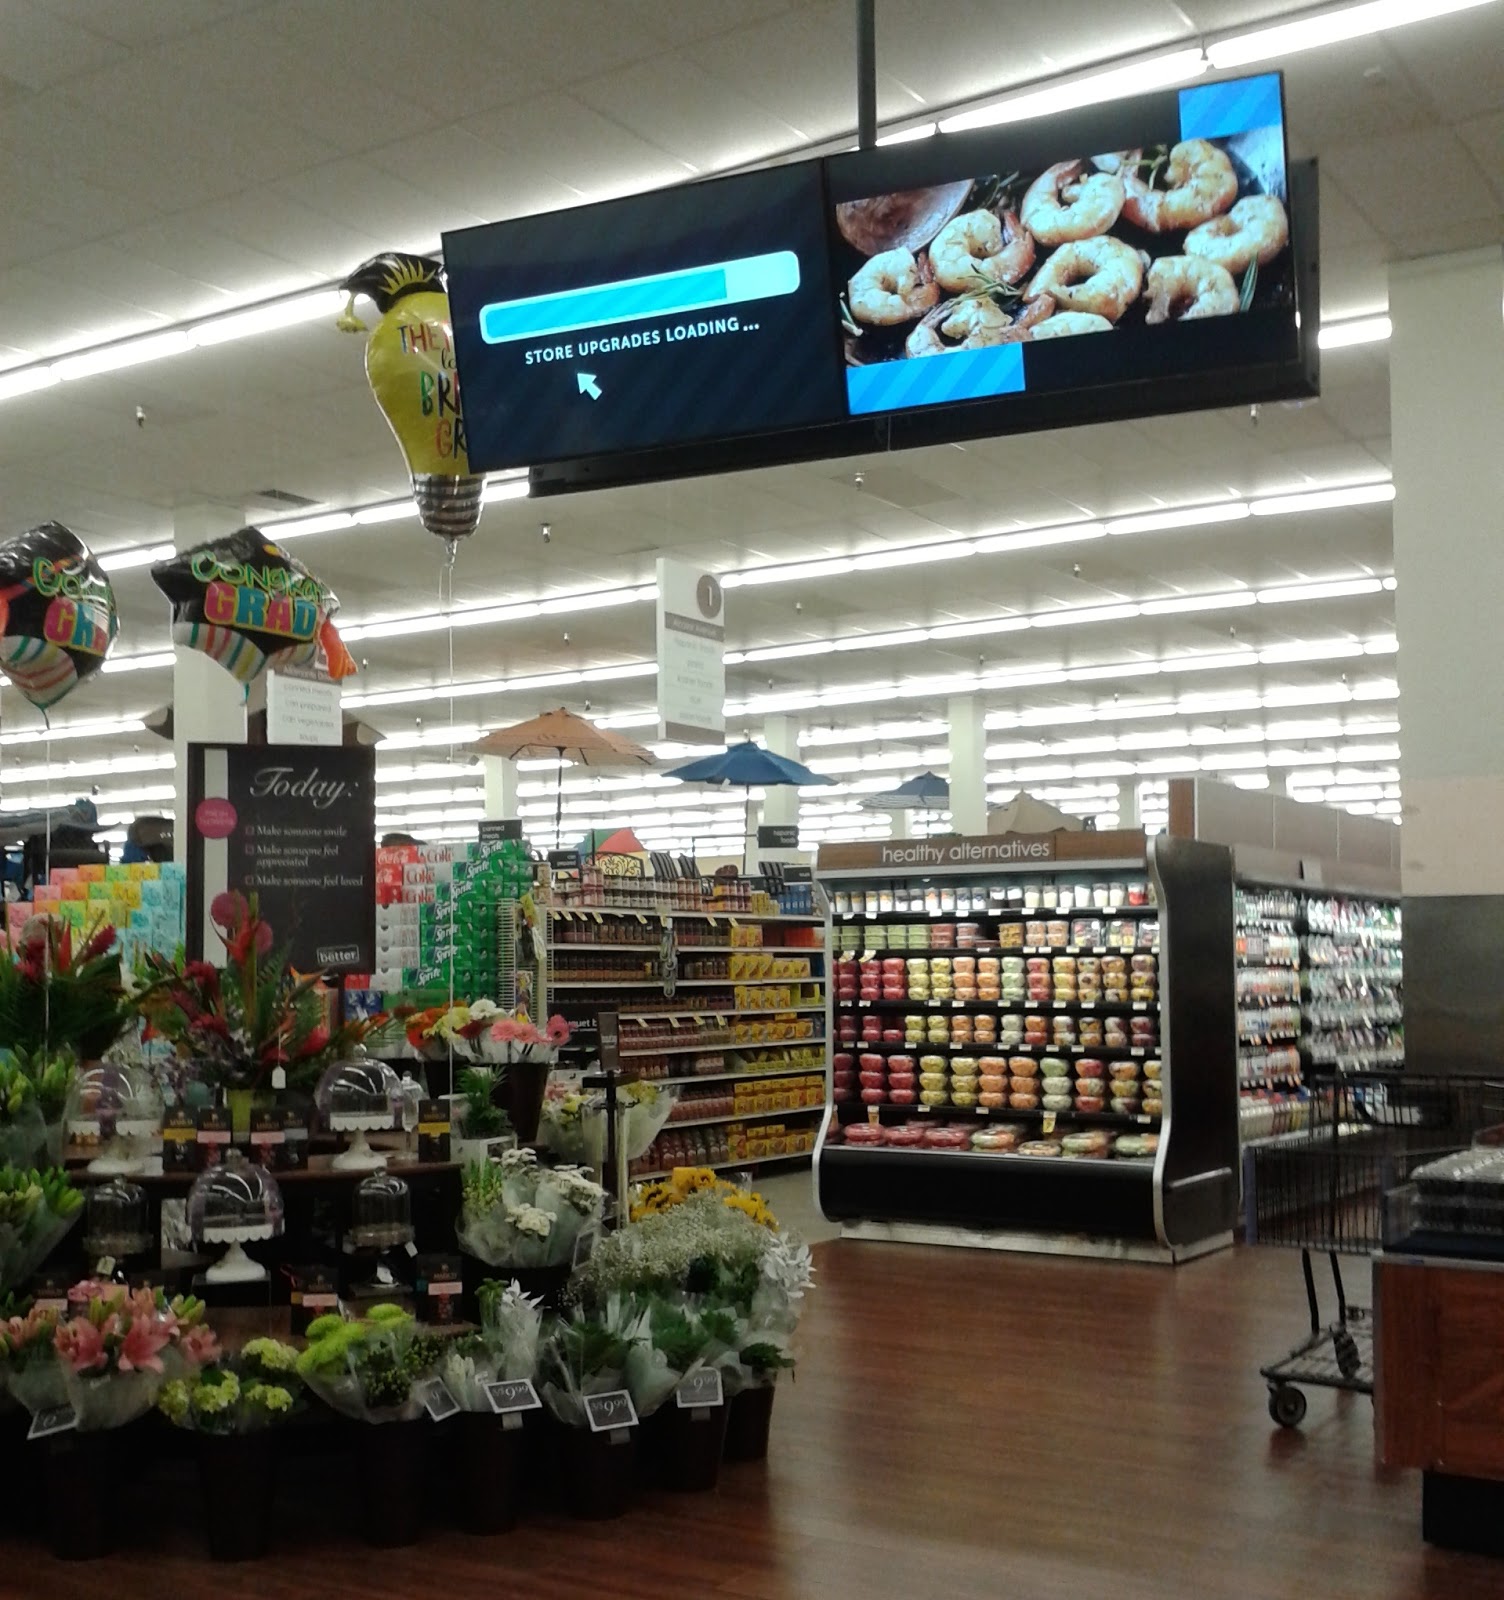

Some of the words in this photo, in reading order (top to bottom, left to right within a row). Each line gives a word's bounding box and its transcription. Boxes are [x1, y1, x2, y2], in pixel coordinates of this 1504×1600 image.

[525, 344, 574, 365] STORE
[578, 329, 661, 357] UPGRADES
[665, 316, 740, 342] LOADING
[205, 582, 318, 641] GRAD
[249, 766, 359, 810] Today:
[257, 824, 281, 837] Make
[283, 827, 322, 837] someone
[323, 825, 348, 837] smile
[257, 844, 282, 856] Make
[283, 846, 322, 857] someone
[321, 844, 339, 859] feel
[882, 844, 946, 864] healthy
[949, 839, 1050, 861] alternatives
[256, 856, 309, 868] appreciated
[467, 860, 490, 878] Sprite
[257, 874, 282, 887] Make
[283, 876, 322, 887] someone
[321, 874, 339, 890] feel
[340, 874, 364, 887] loved
[451, 881, 473, 899] Sprite
[417, 968, 442, 986] Sprite
